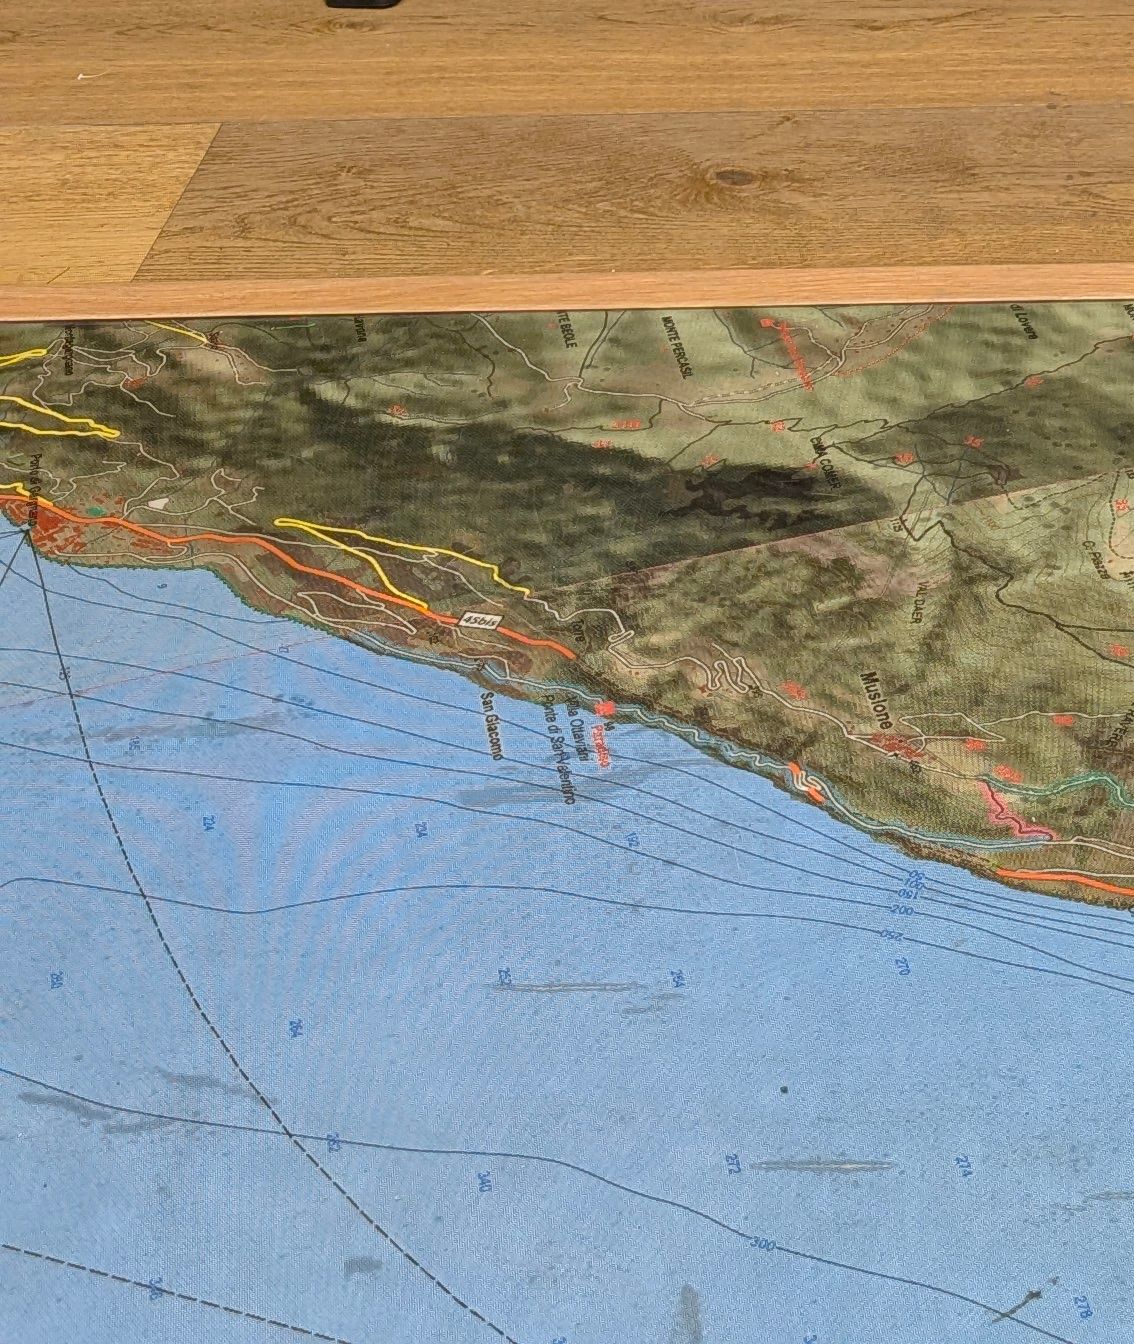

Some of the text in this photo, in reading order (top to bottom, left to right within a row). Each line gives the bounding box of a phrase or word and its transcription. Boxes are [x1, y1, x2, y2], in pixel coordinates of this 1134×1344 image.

[661, 315, 681, 346] MONTE
[461, 614, 499, 629] 45bis
[859, 671, 893, 731] Muslone
[480, 691, 504, 761] San Giacomo
[725, 1153, 742, 1175] 272
[954, 1155, 974, 1178] 274
[749, 1236, 776, 1252] 300
[1074, 1295, 1093, 1320] 278
